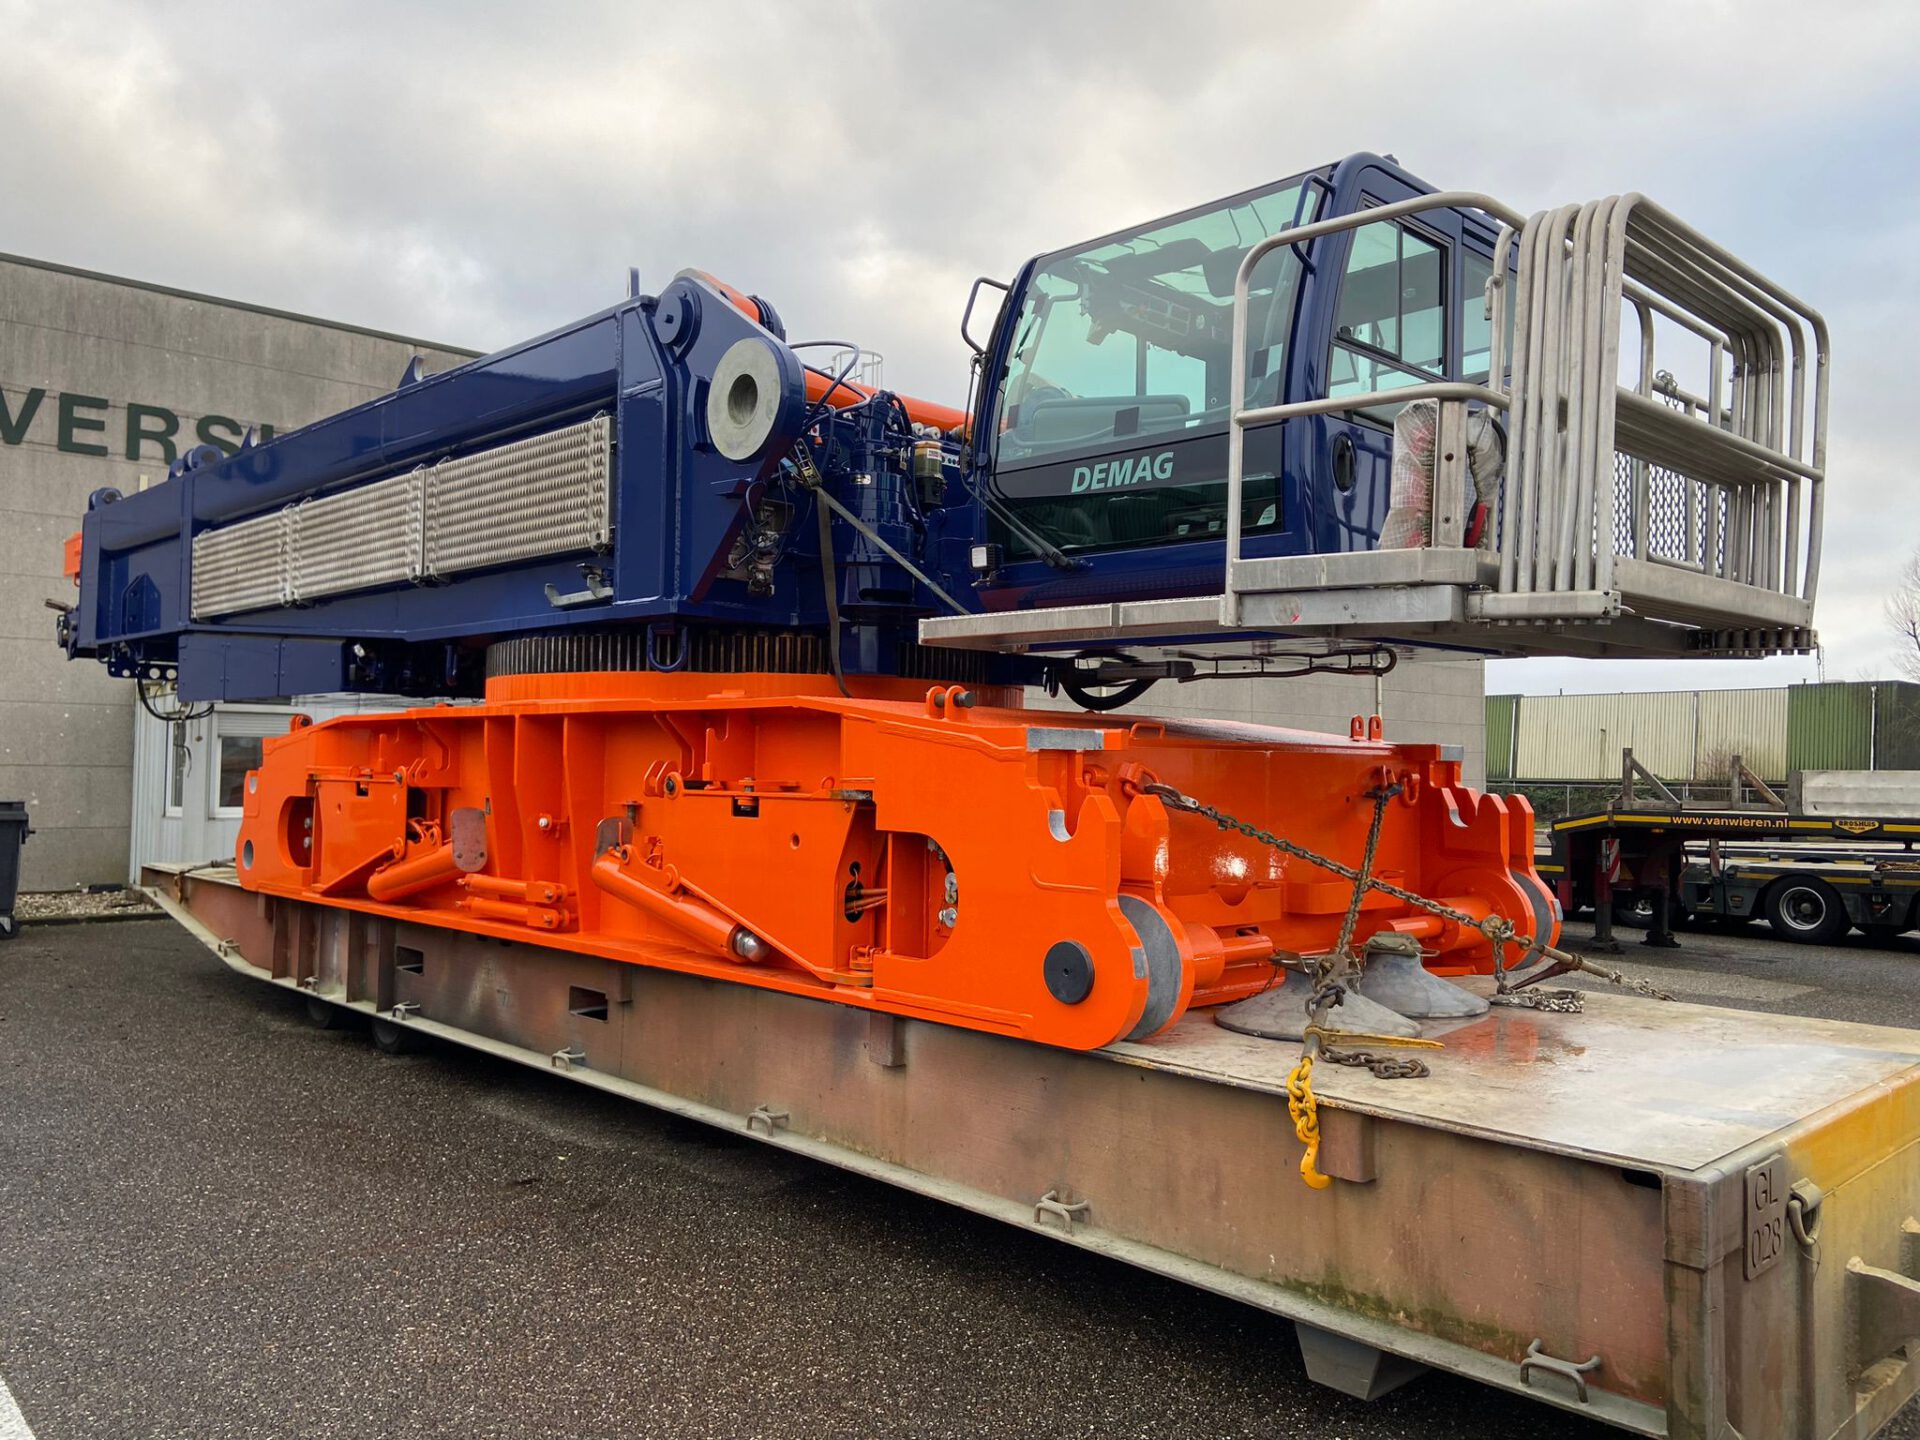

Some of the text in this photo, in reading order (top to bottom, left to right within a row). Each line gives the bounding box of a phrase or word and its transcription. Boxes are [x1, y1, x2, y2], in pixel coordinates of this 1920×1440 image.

[1071, 451, 1174, 493] DEMAG
[1671, 816, 1788, 828] www.vanwieren.nl
[1755, 1167, 1779, 1211] GL
[1751, 1217, 1781, 1269] 028
